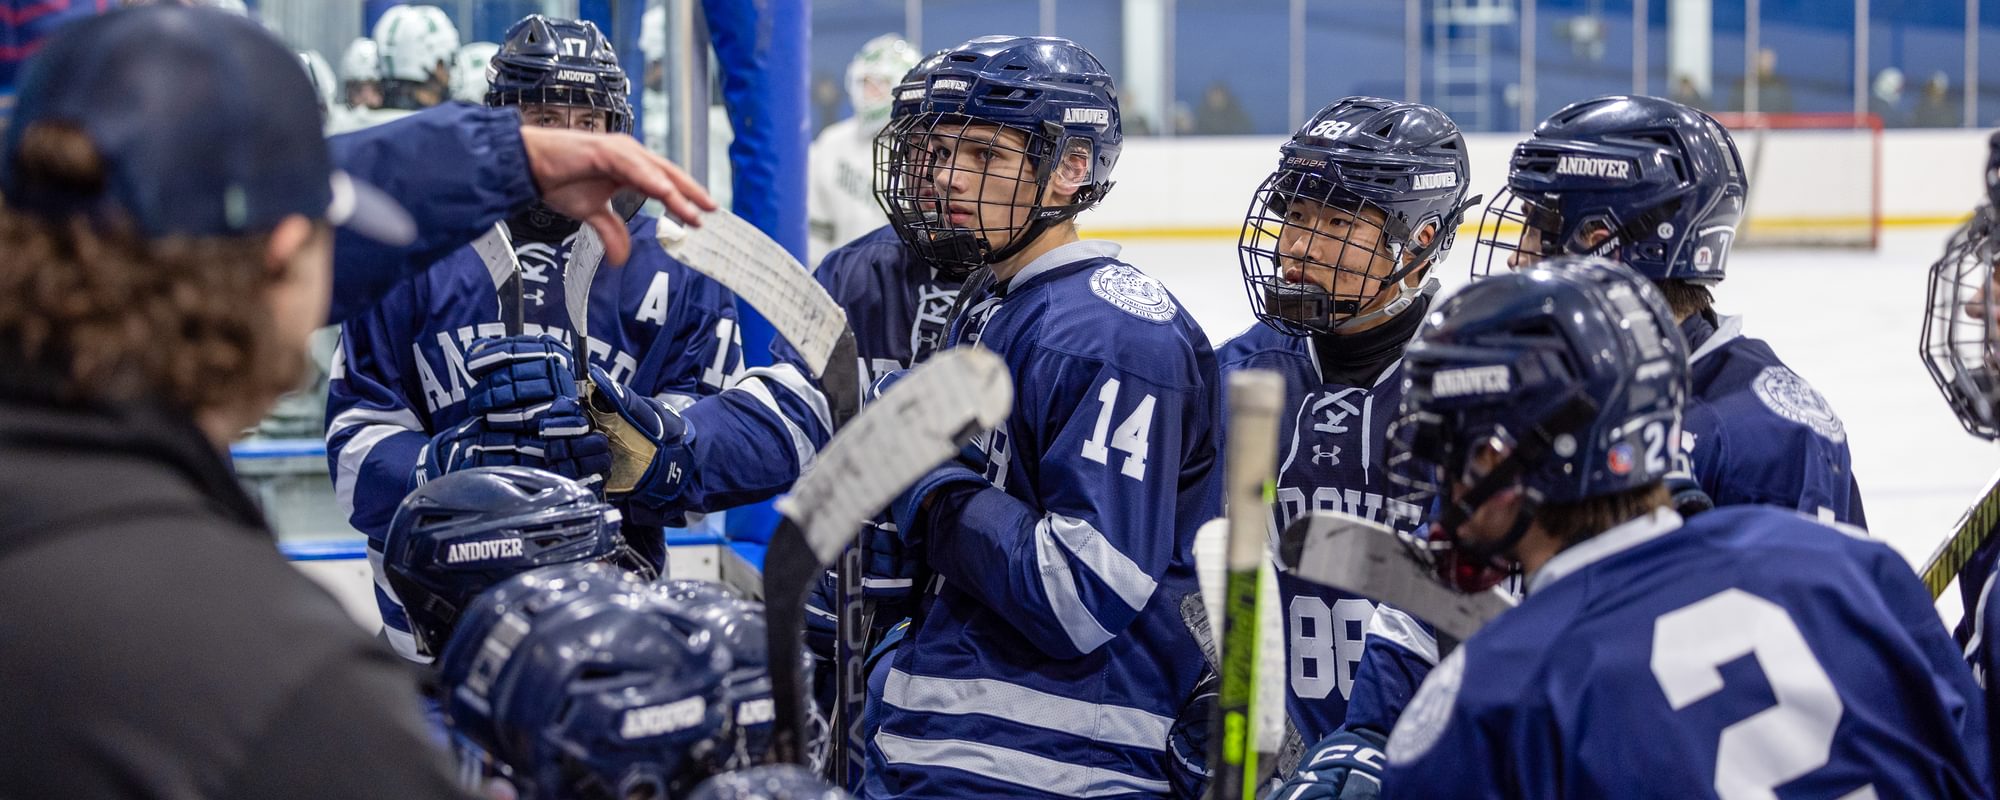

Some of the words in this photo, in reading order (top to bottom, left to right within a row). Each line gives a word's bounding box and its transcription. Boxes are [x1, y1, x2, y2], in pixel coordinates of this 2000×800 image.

[562, 37, 587, 57] 17
[557, 69, 596, 83] ANDOVER
[932, 79, 968, 92] ANDOVER
[1062, 107, 1109, 126] ANDOVER
[1309, 120, 1351, 139] 88
[1286, 156, 1328, 169] BAUER
[1556, 156, 1629, 179] ANDOVER
[1412, 171, 1457, 190] ANDOVER
[1590, 236, 1621, 260] UER
[636, 271, 669, 326] A
[1081, 377, 1157, 482] 14
[447, 538, 523, 563] ANDOVER
[1289, 595, 1376, 701] 88
[1650, 587, 1878, 800] 2
